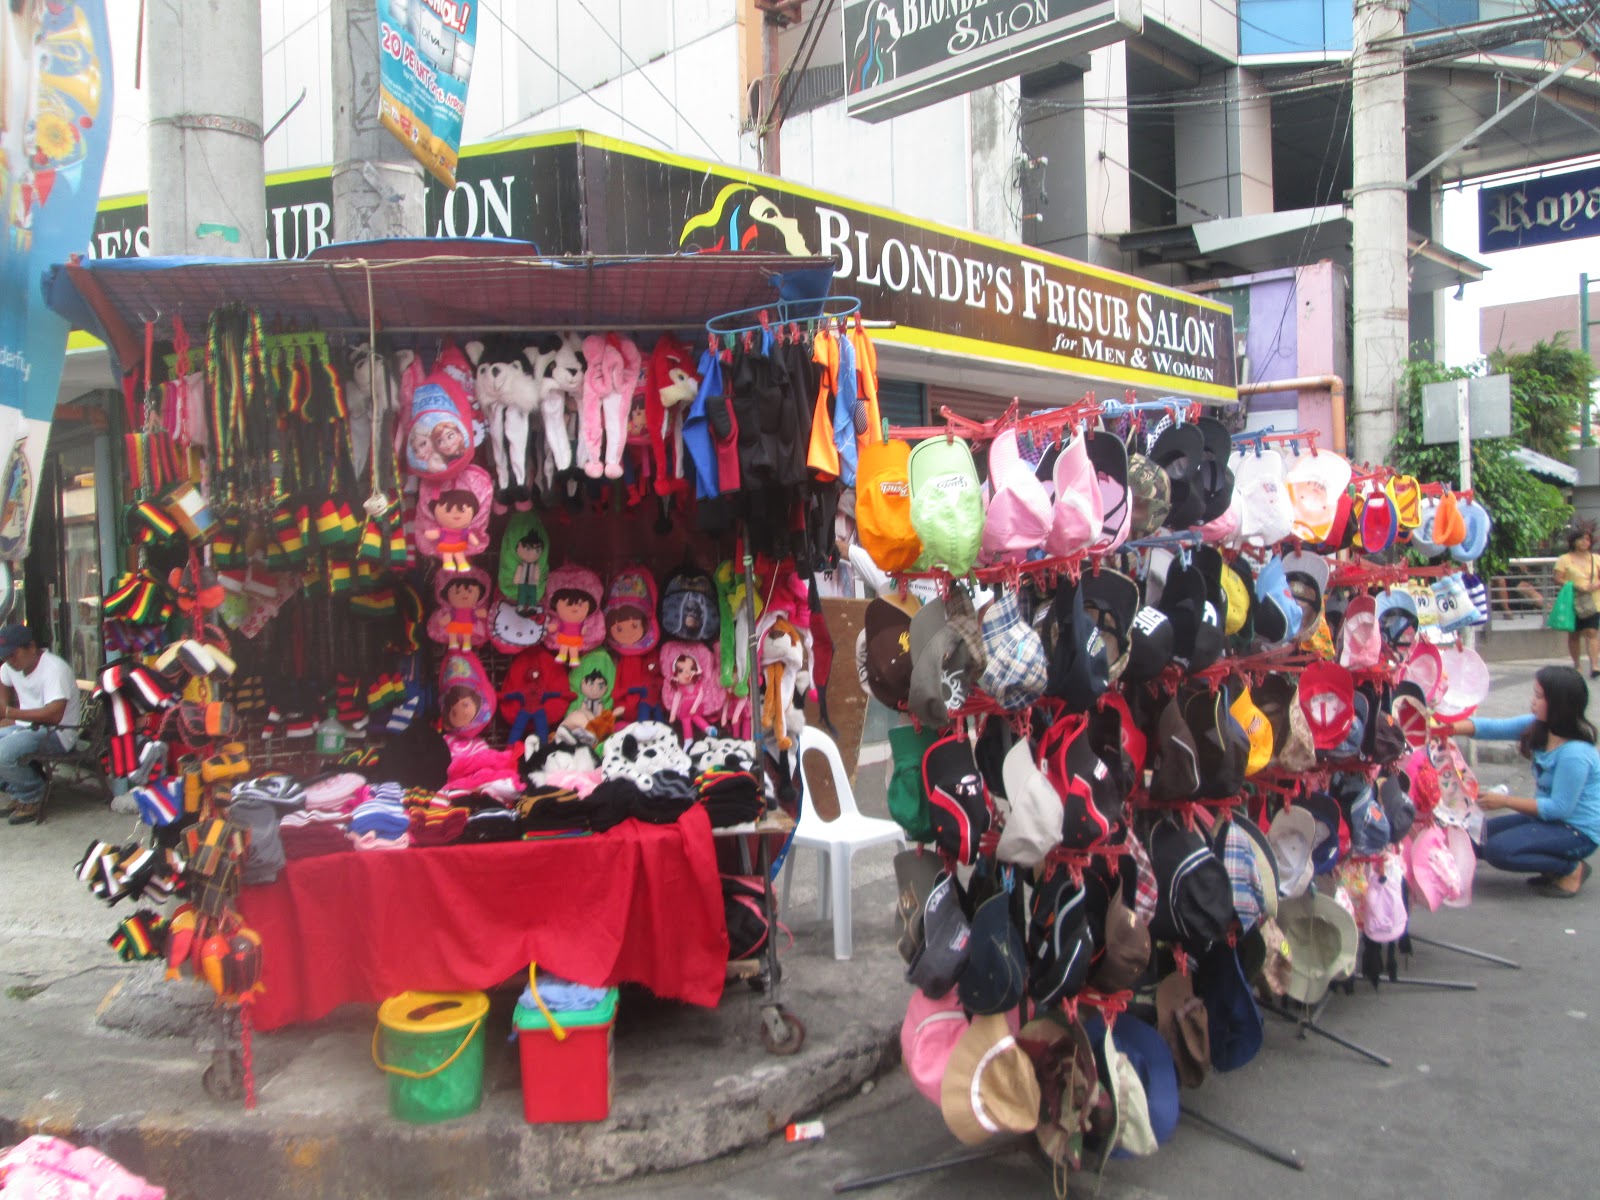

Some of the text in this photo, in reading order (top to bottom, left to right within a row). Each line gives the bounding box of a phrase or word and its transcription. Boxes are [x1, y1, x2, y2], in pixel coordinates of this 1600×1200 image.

[381, 22, 402, 60] 20
[947, 0, 1049, 55] SALON
[815, 206, 1215, 359] BLONDE'S FRISUR SALON
[1052, 333, 1214, 382] for MEN & WOMEN
